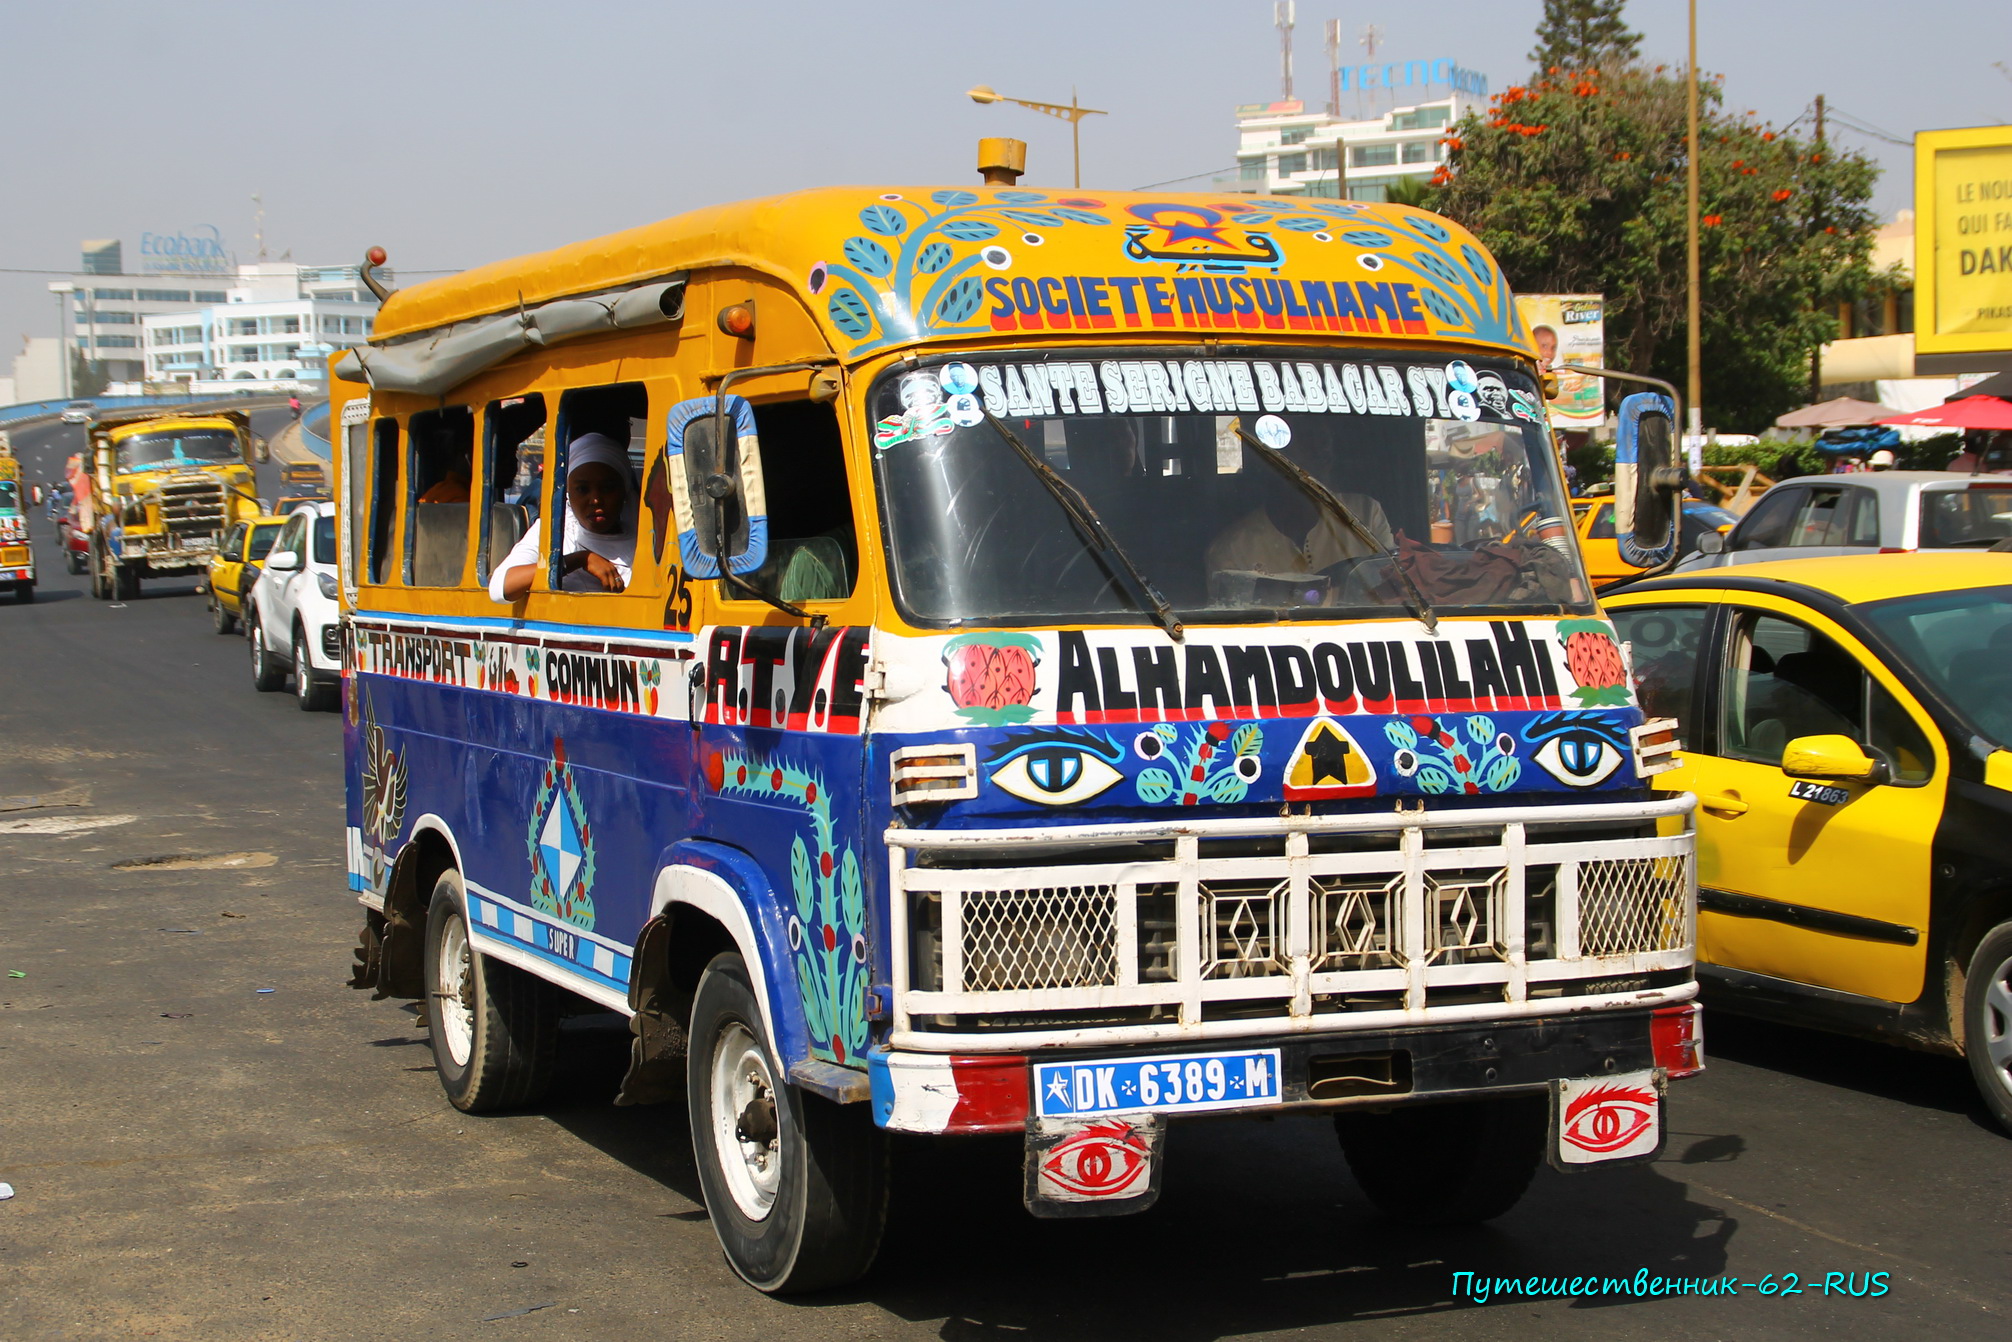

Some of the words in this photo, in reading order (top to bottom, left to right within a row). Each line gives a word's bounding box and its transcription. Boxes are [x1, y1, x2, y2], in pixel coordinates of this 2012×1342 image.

[1339, 57, 1455, 91] TECNO
[1957, 182, 1975, 204] LE
[140, 229, 227, 258] Ecobank
[1957, 213, 1988, 235] QUI
[984, 275, 1177, 331] SOCIETE
[1173, 276, 1430, 335] MUSULMANE
[979, 362, 1104, 418] SANTE
[1100, 360, 1260, 413] SERIGNE
[1253, 361, 1412, 417] BABACAR
[1406, 365, 1452, 418] SY
[663, 564, 692, 632] 25
[368, 632, 471, 688] TRANSPORT
[546, 650, 641, 715] COMMUN
[1056, 620, 1563, 725] ALHAMDOULILAHI
[1790, 781, 1801, 796] L
[1802, 784, 1849, 804] 21863
[548, 927, 575, 960] SUPER
[1075, 1066, 1119, 1111] DK
[1139, 1058, 1226, 1106] 6389
[1245, 1056, 1270, 1097] M
